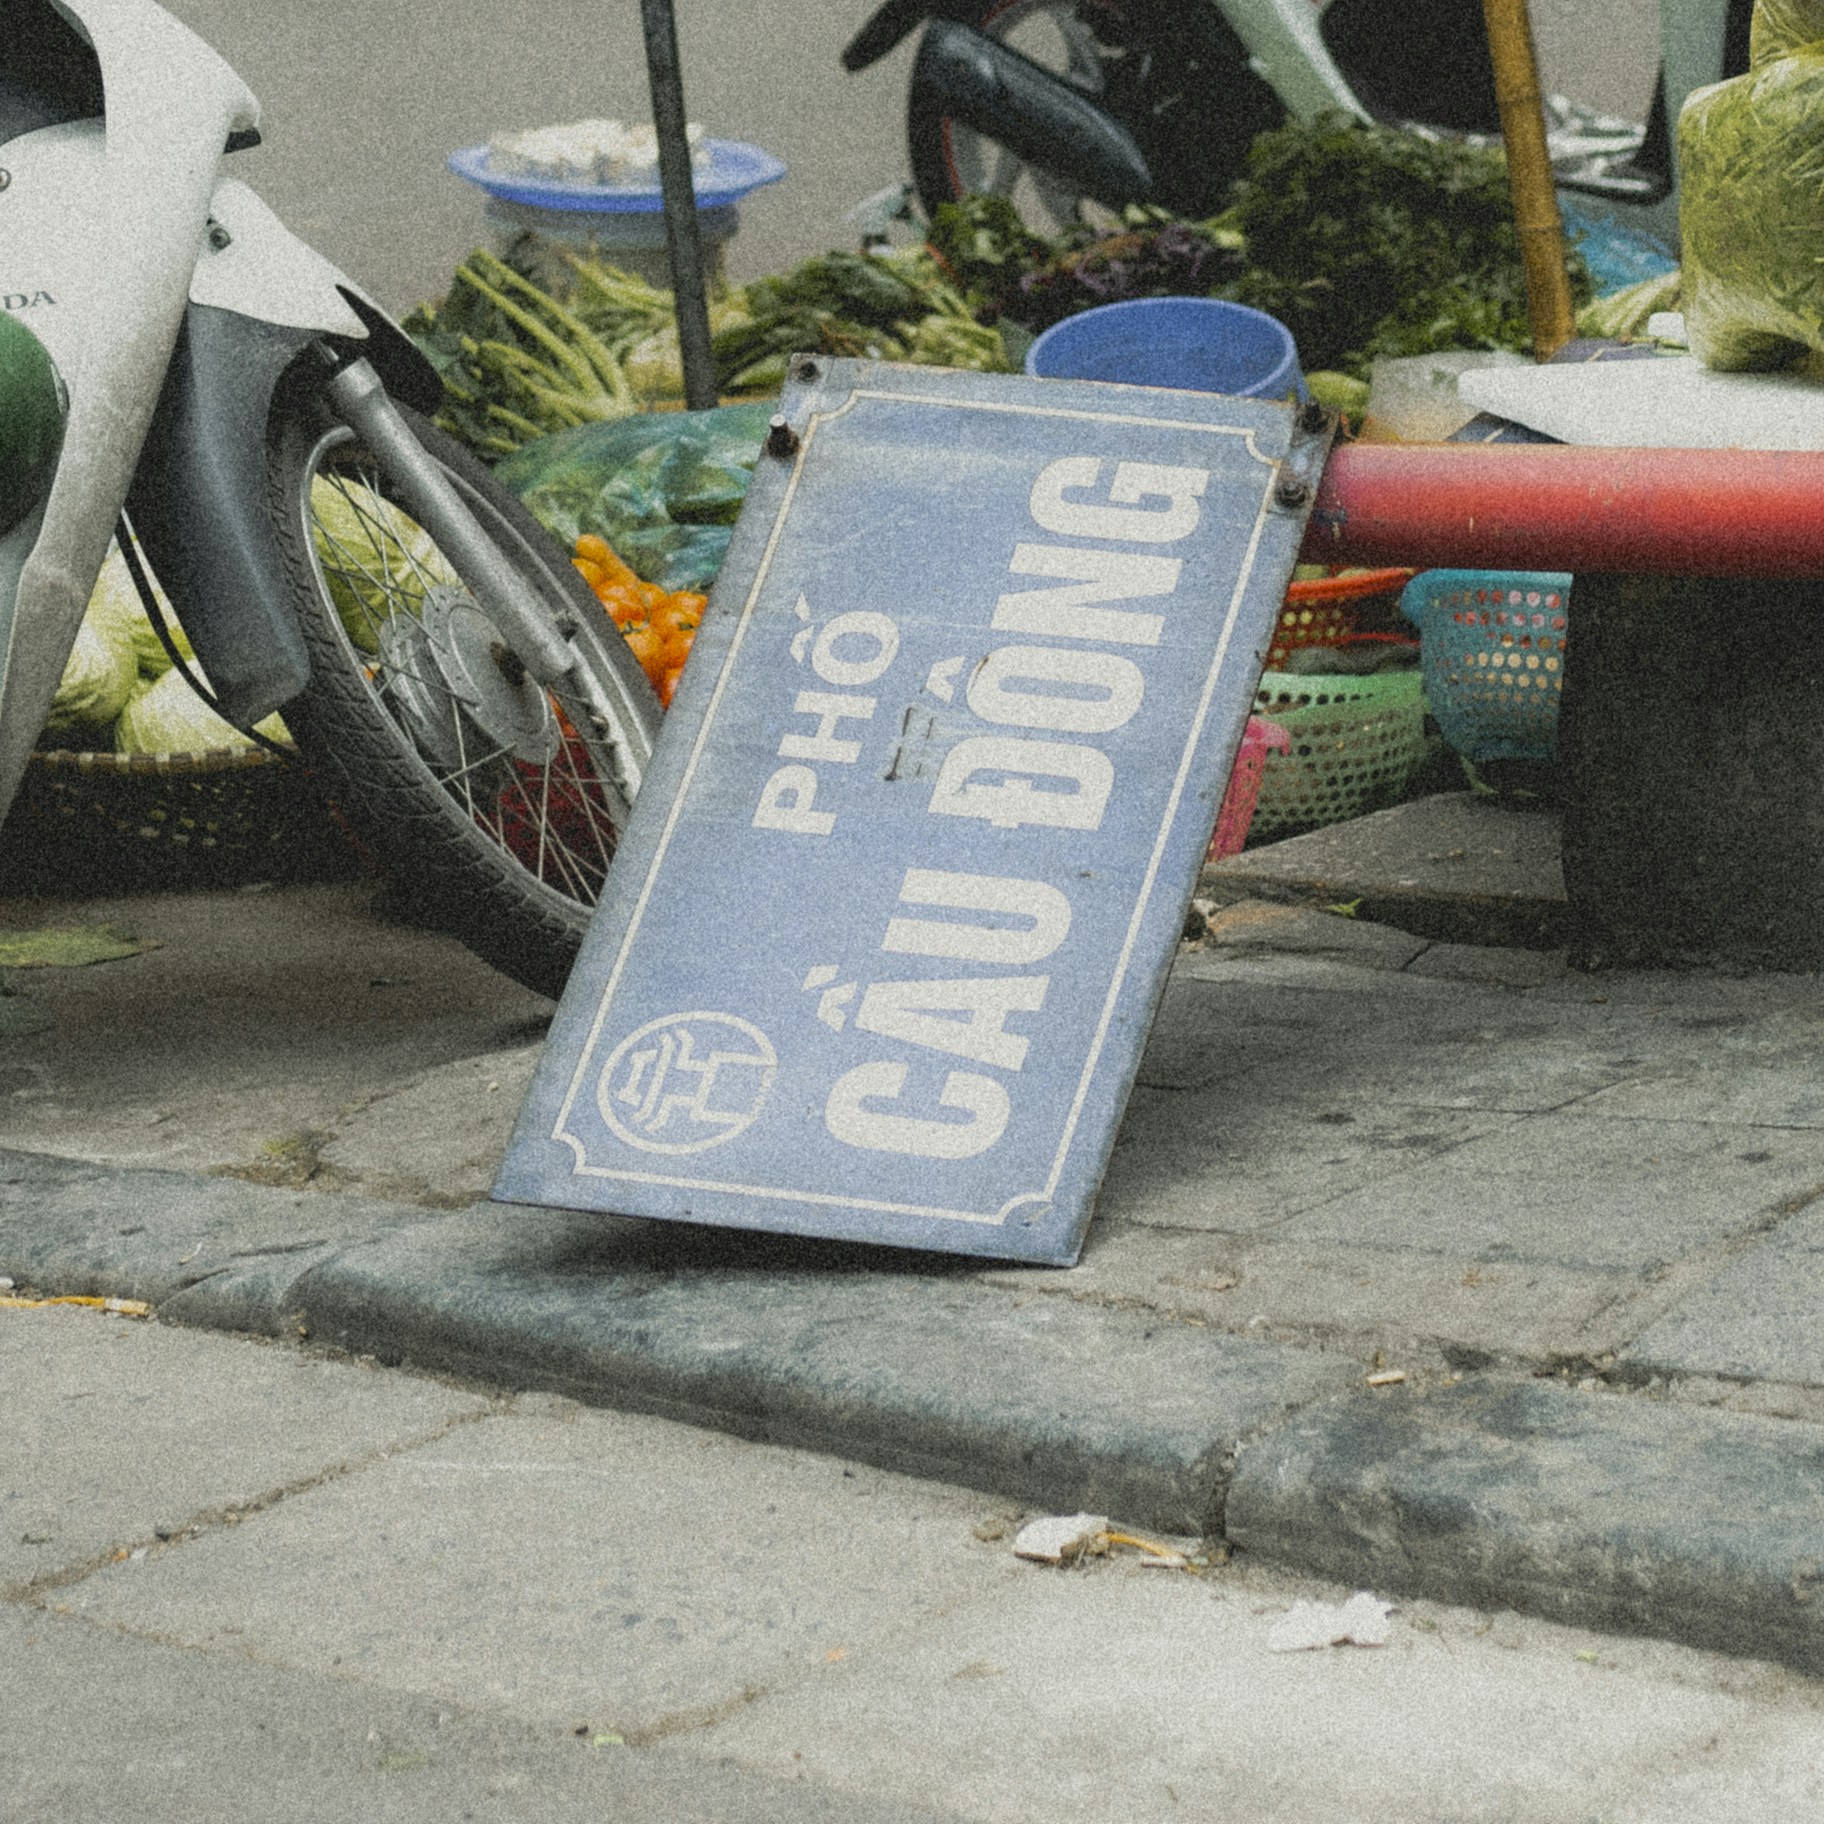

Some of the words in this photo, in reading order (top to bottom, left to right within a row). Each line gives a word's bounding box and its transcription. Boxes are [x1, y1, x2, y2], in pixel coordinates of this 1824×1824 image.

[751, 594, 901, 836] PHỐ
[924, 455, 1211, 832] ĐÔNG
[800, 865, 1074, 1161] CẦU
